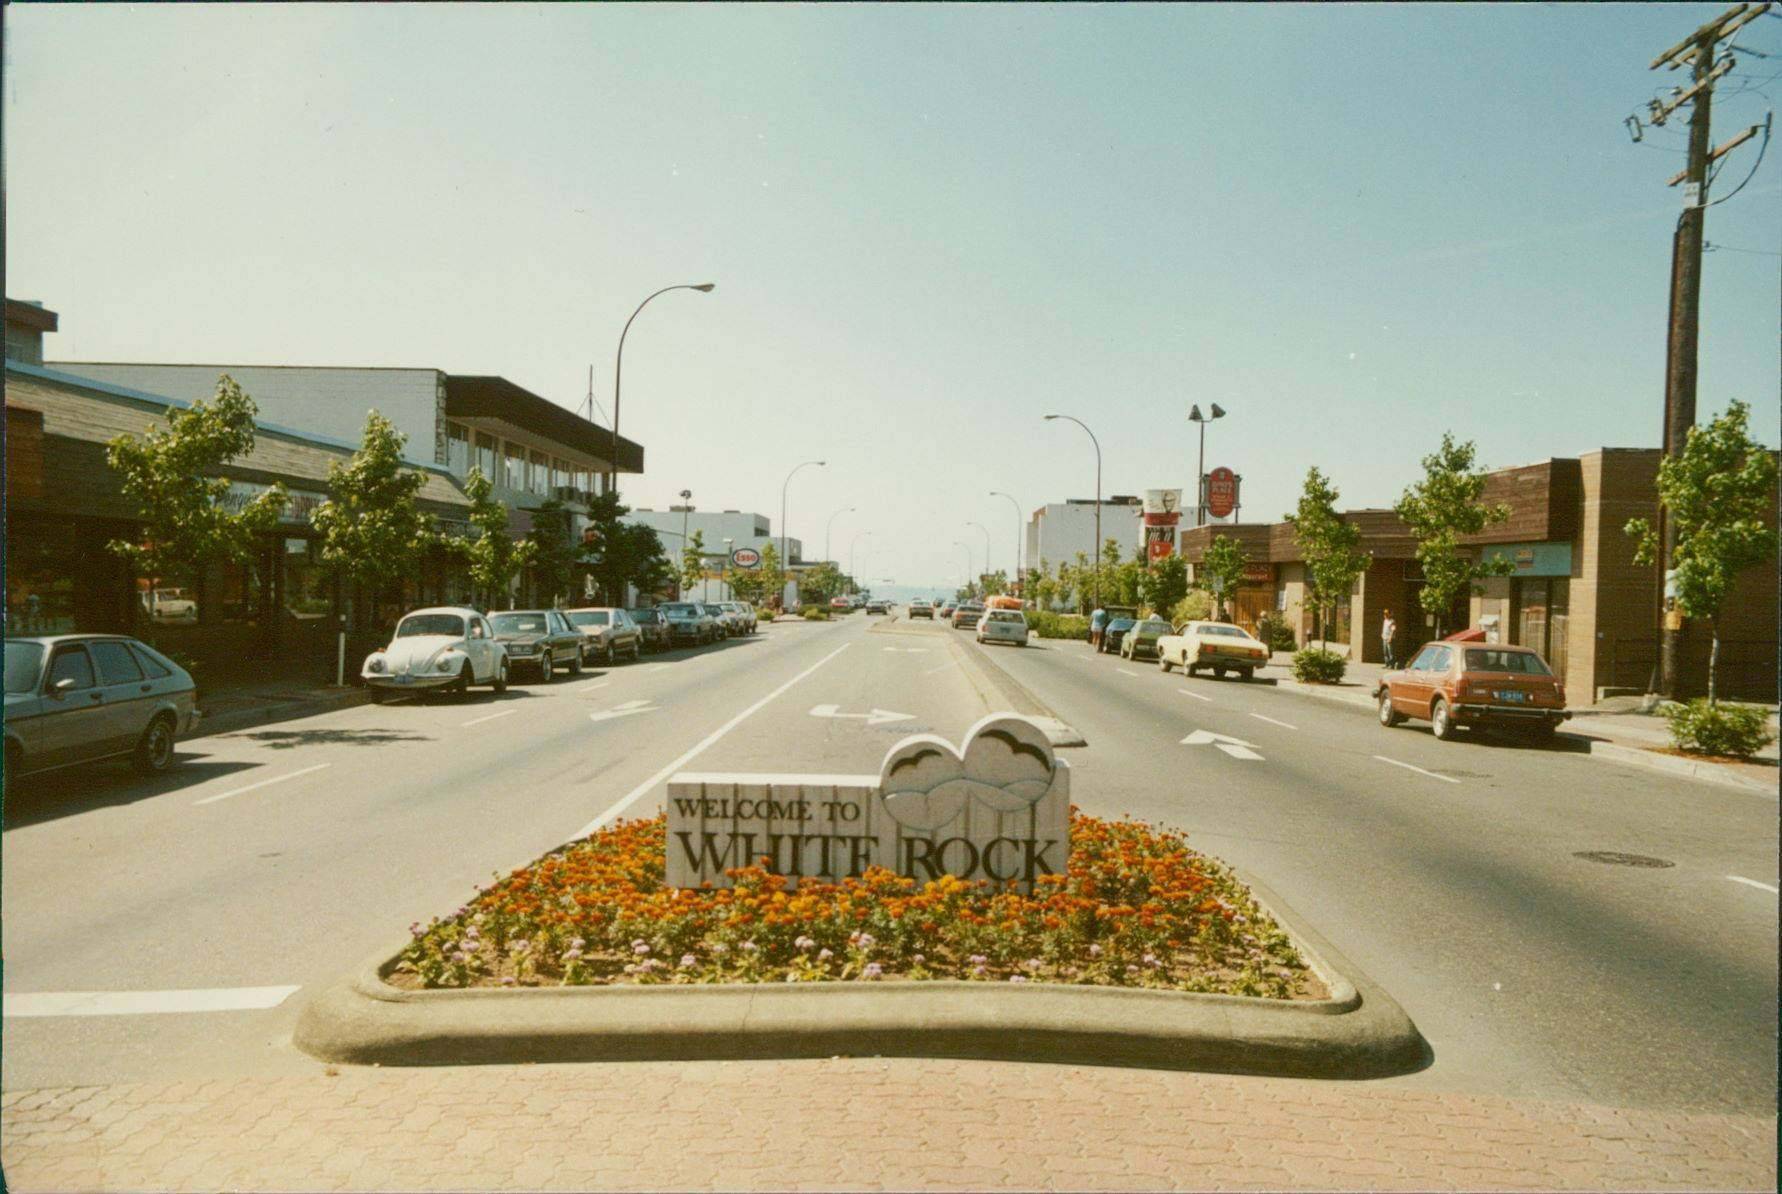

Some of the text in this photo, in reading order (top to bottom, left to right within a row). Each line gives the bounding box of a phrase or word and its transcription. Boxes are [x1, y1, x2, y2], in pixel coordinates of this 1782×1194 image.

[736, 552, 756, 562] Esso
[674, 798, 860, 821] WELCOME TO
[674, 831, 1058, 881] WHITE ROCK
